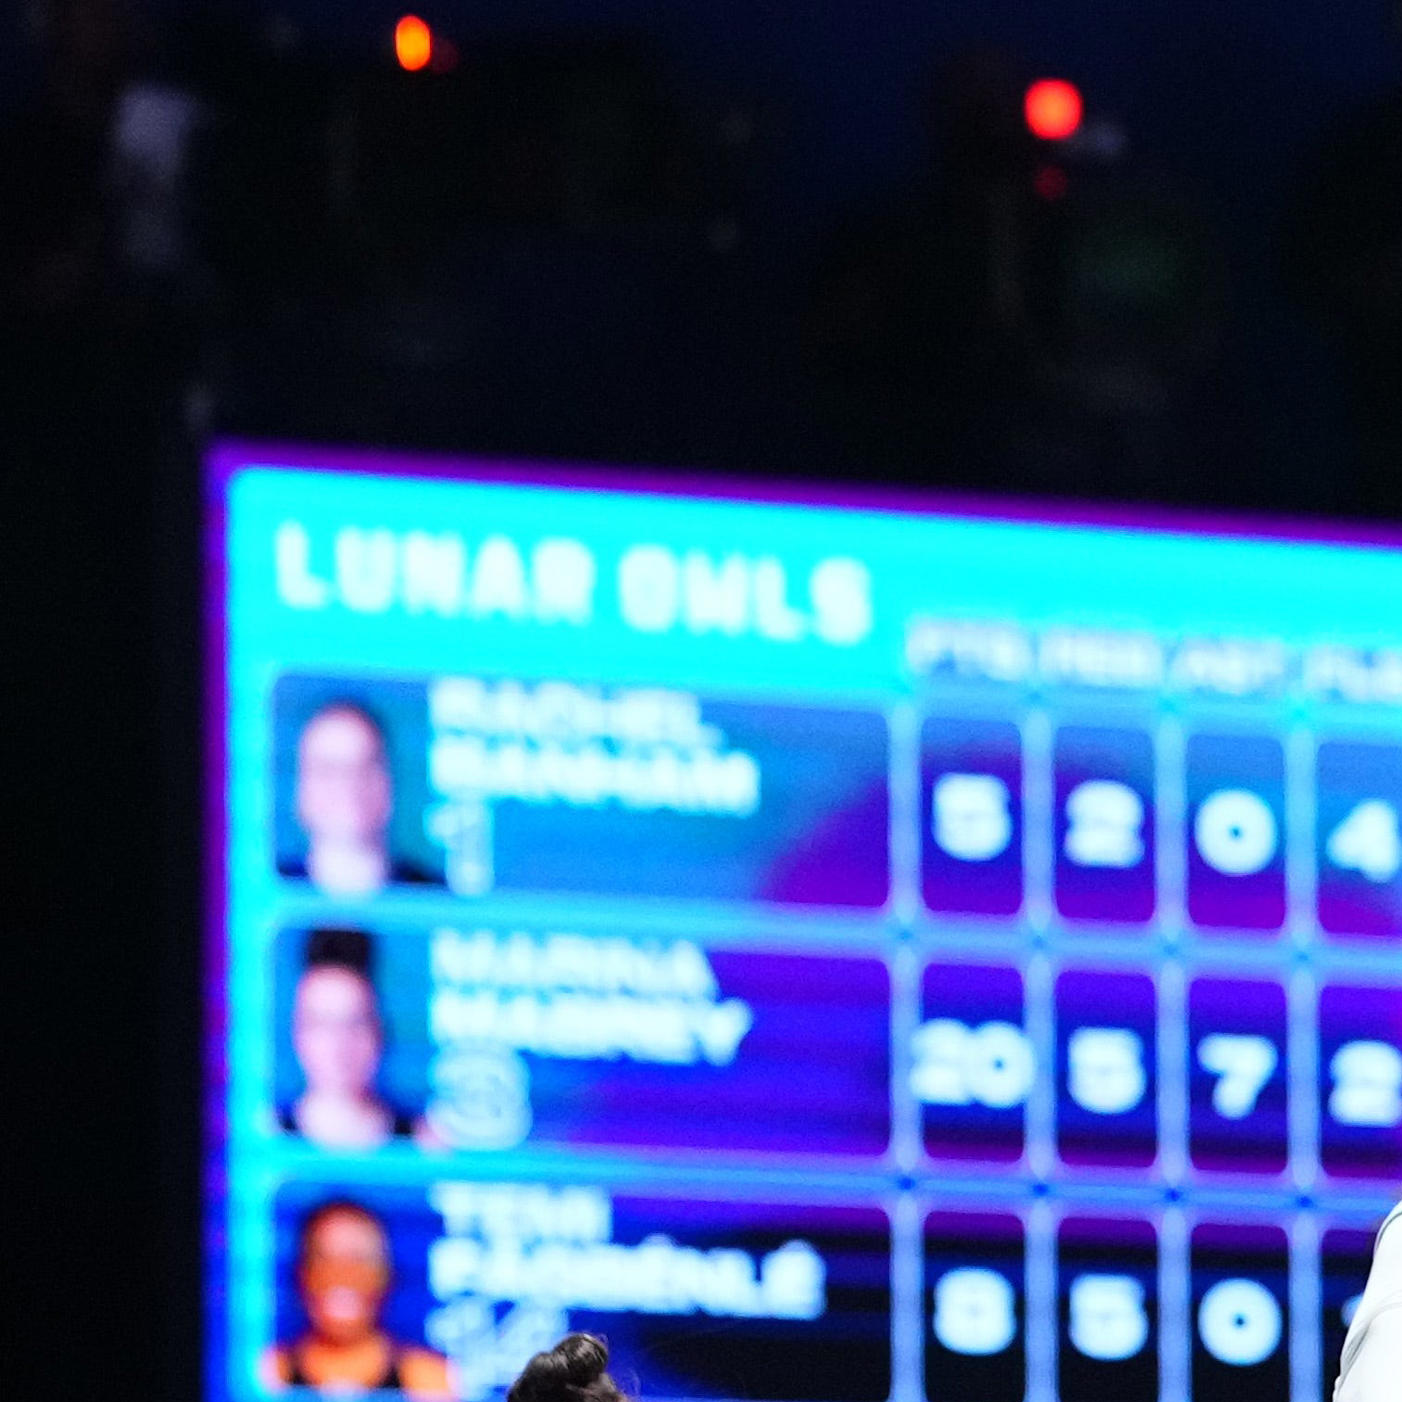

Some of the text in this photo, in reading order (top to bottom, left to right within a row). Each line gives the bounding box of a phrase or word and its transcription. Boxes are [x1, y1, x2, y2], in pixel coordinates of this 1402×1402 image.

[276, 521, 871, 645] LUNAR OWLS
[1195, 789, 1277, 875] 0
[1326, 800, 1401, 882] 4
[909, 1018, 1035, 1107] 20
[1068, 1028, 1145, 1114] 5
[1198, 1035, 1277, 1118] 7
[1069, 1274, 1147, 1359] 5
[1199, 1278, 1281, 1365] 0
